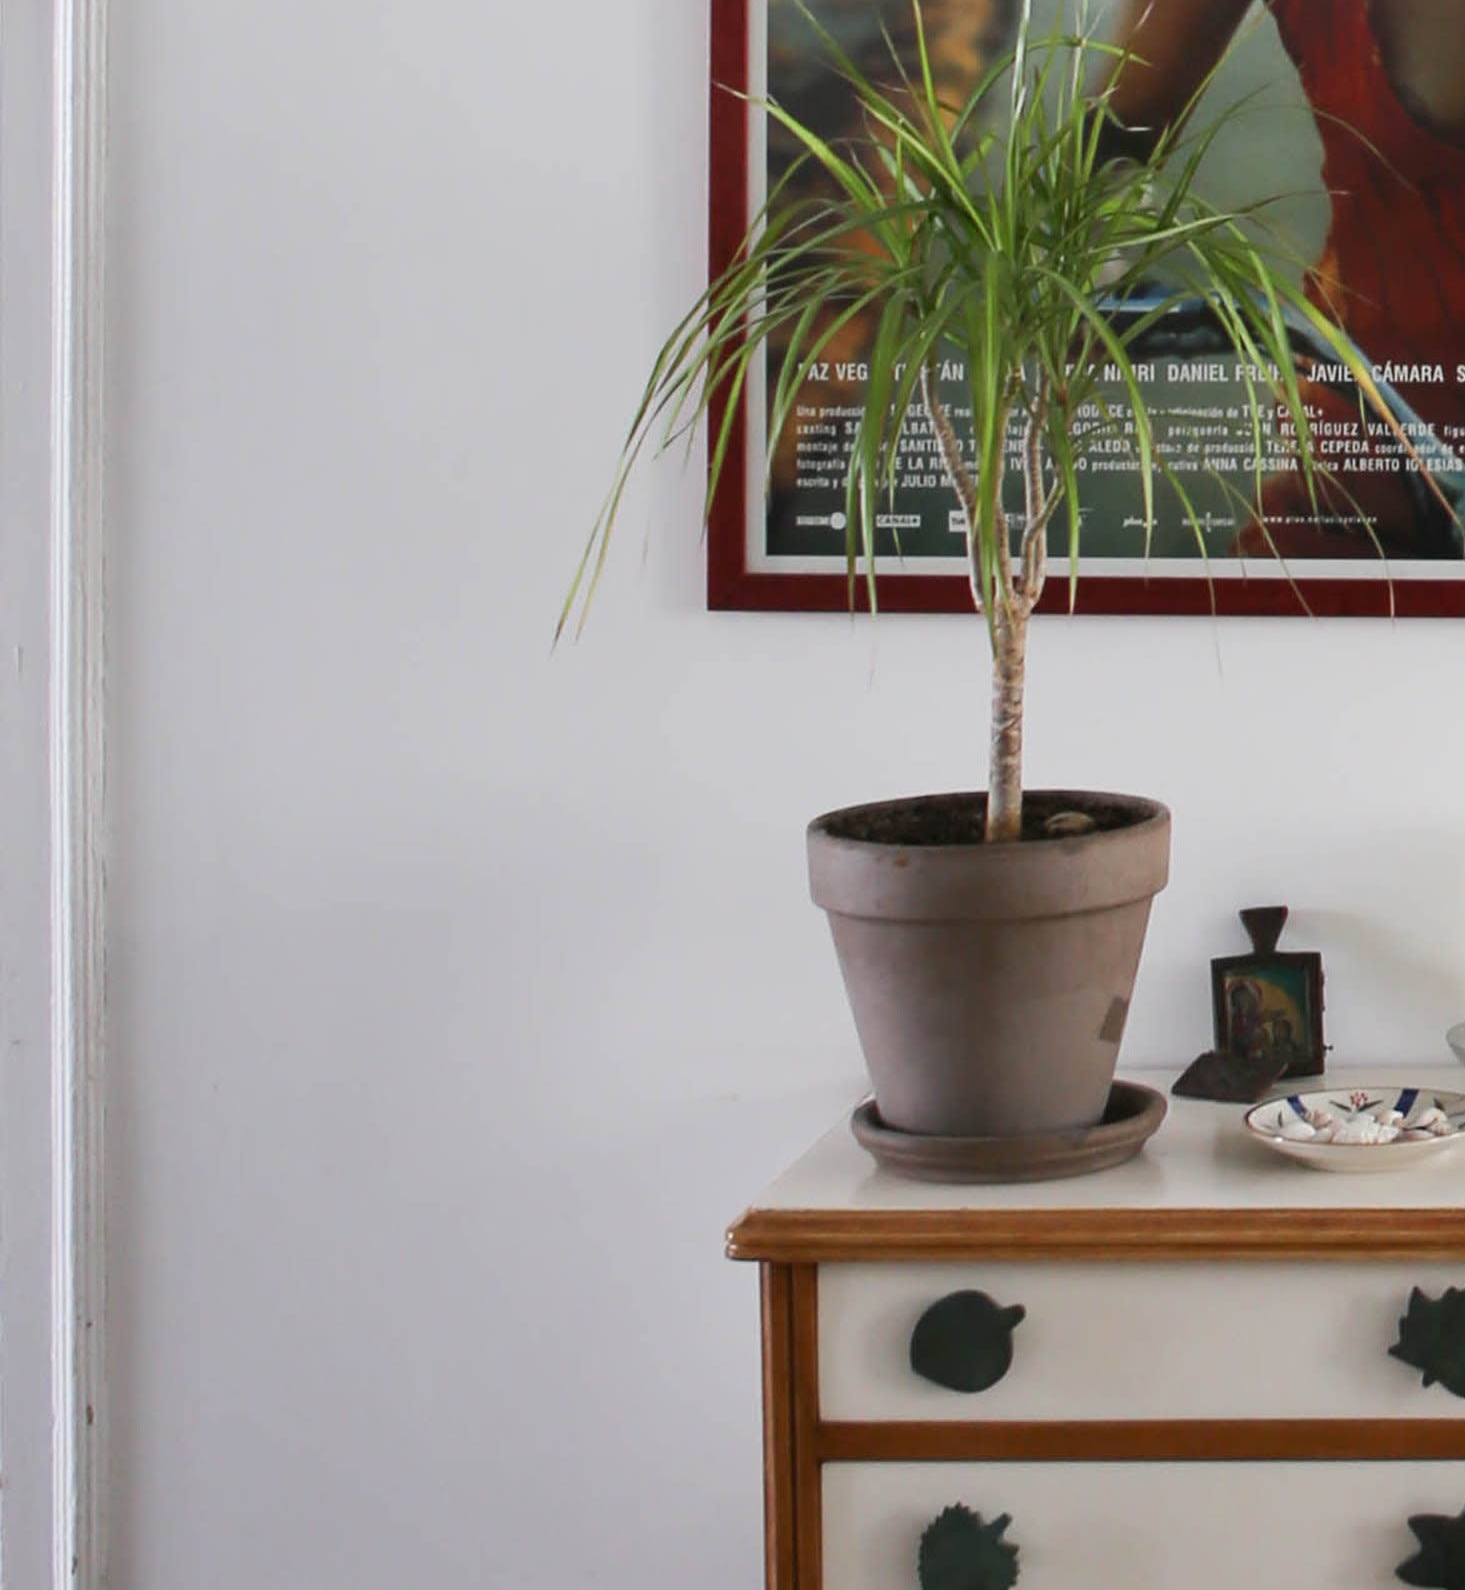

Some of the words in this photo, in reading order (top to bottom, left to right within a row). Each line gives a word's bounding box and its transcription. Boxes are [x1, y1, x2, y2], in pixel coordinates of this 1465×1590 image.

[798, 362, 830, 381] AZ
[835, 362, 869, 381] VEG
[1103, 363, 1155, 382] NIRI
[1167, 363, 1229, 382] DANIEL
[1306, 363, 1358, 383] JAVIE
[1372, 359, 1445, 383] CÁMARA
[1320, 440, 1370, 454] CEPEDA
[1343, 458, 1400, 472] ALBERTO
